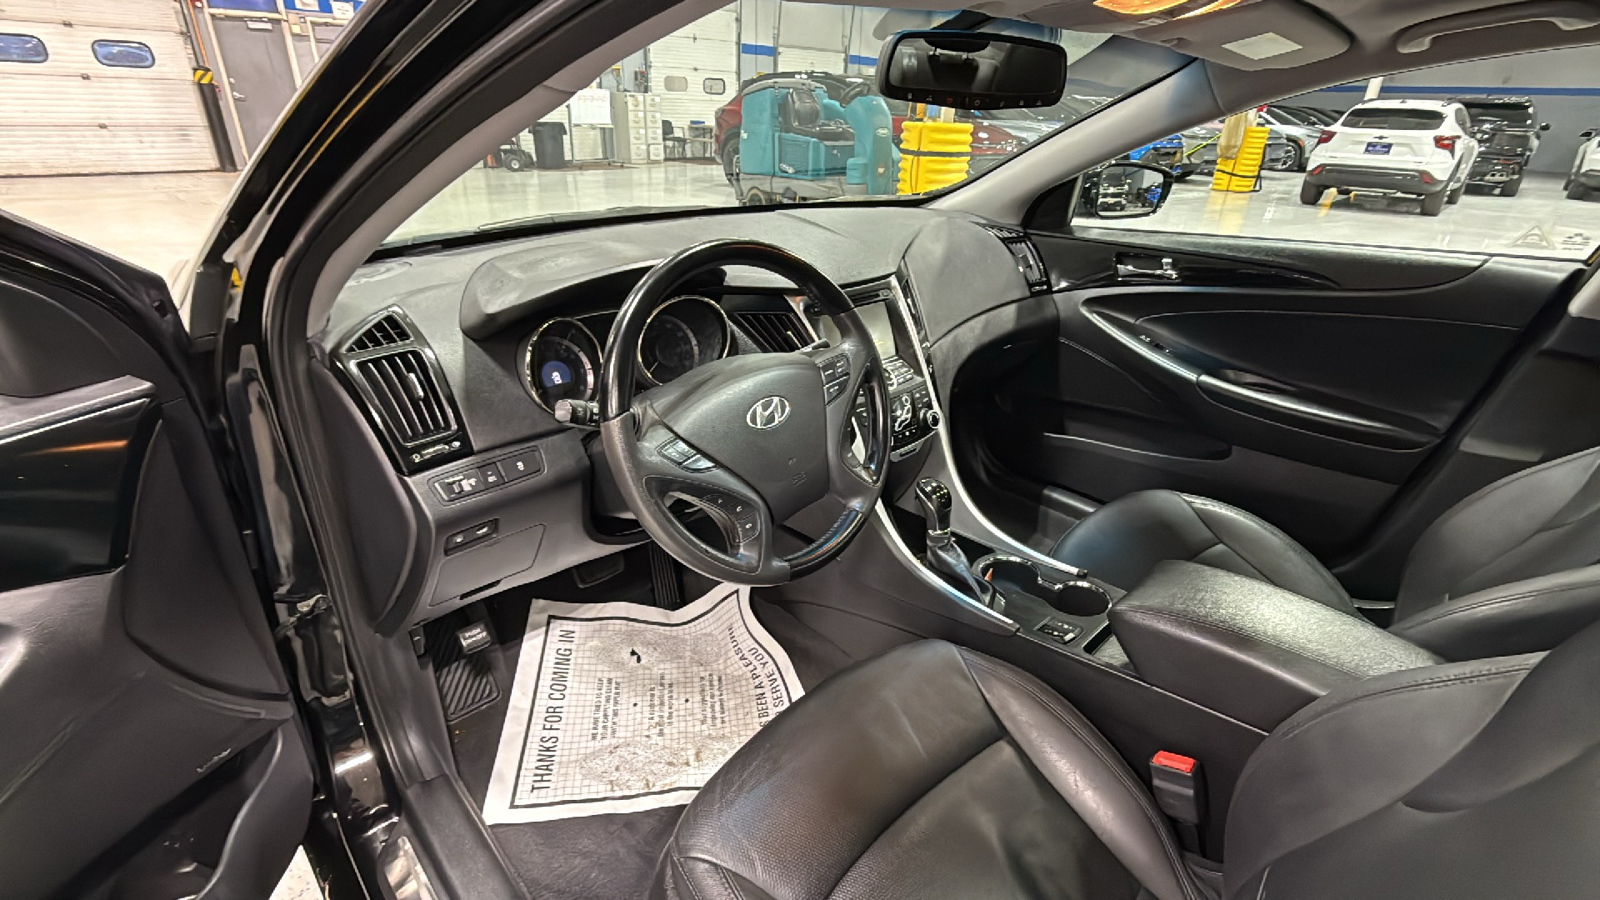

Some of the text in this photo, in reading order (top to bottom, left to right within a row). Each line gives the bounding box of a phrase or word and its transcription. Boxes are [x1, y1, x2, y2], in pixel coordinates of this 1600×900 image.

[748, 647, 784, 708] SERVE YOU
[754, 681, 765, 689] A
[530, 629, 576, 793] THANKS FOR COMING IN
[755, 692, 769, 719] BEEN
